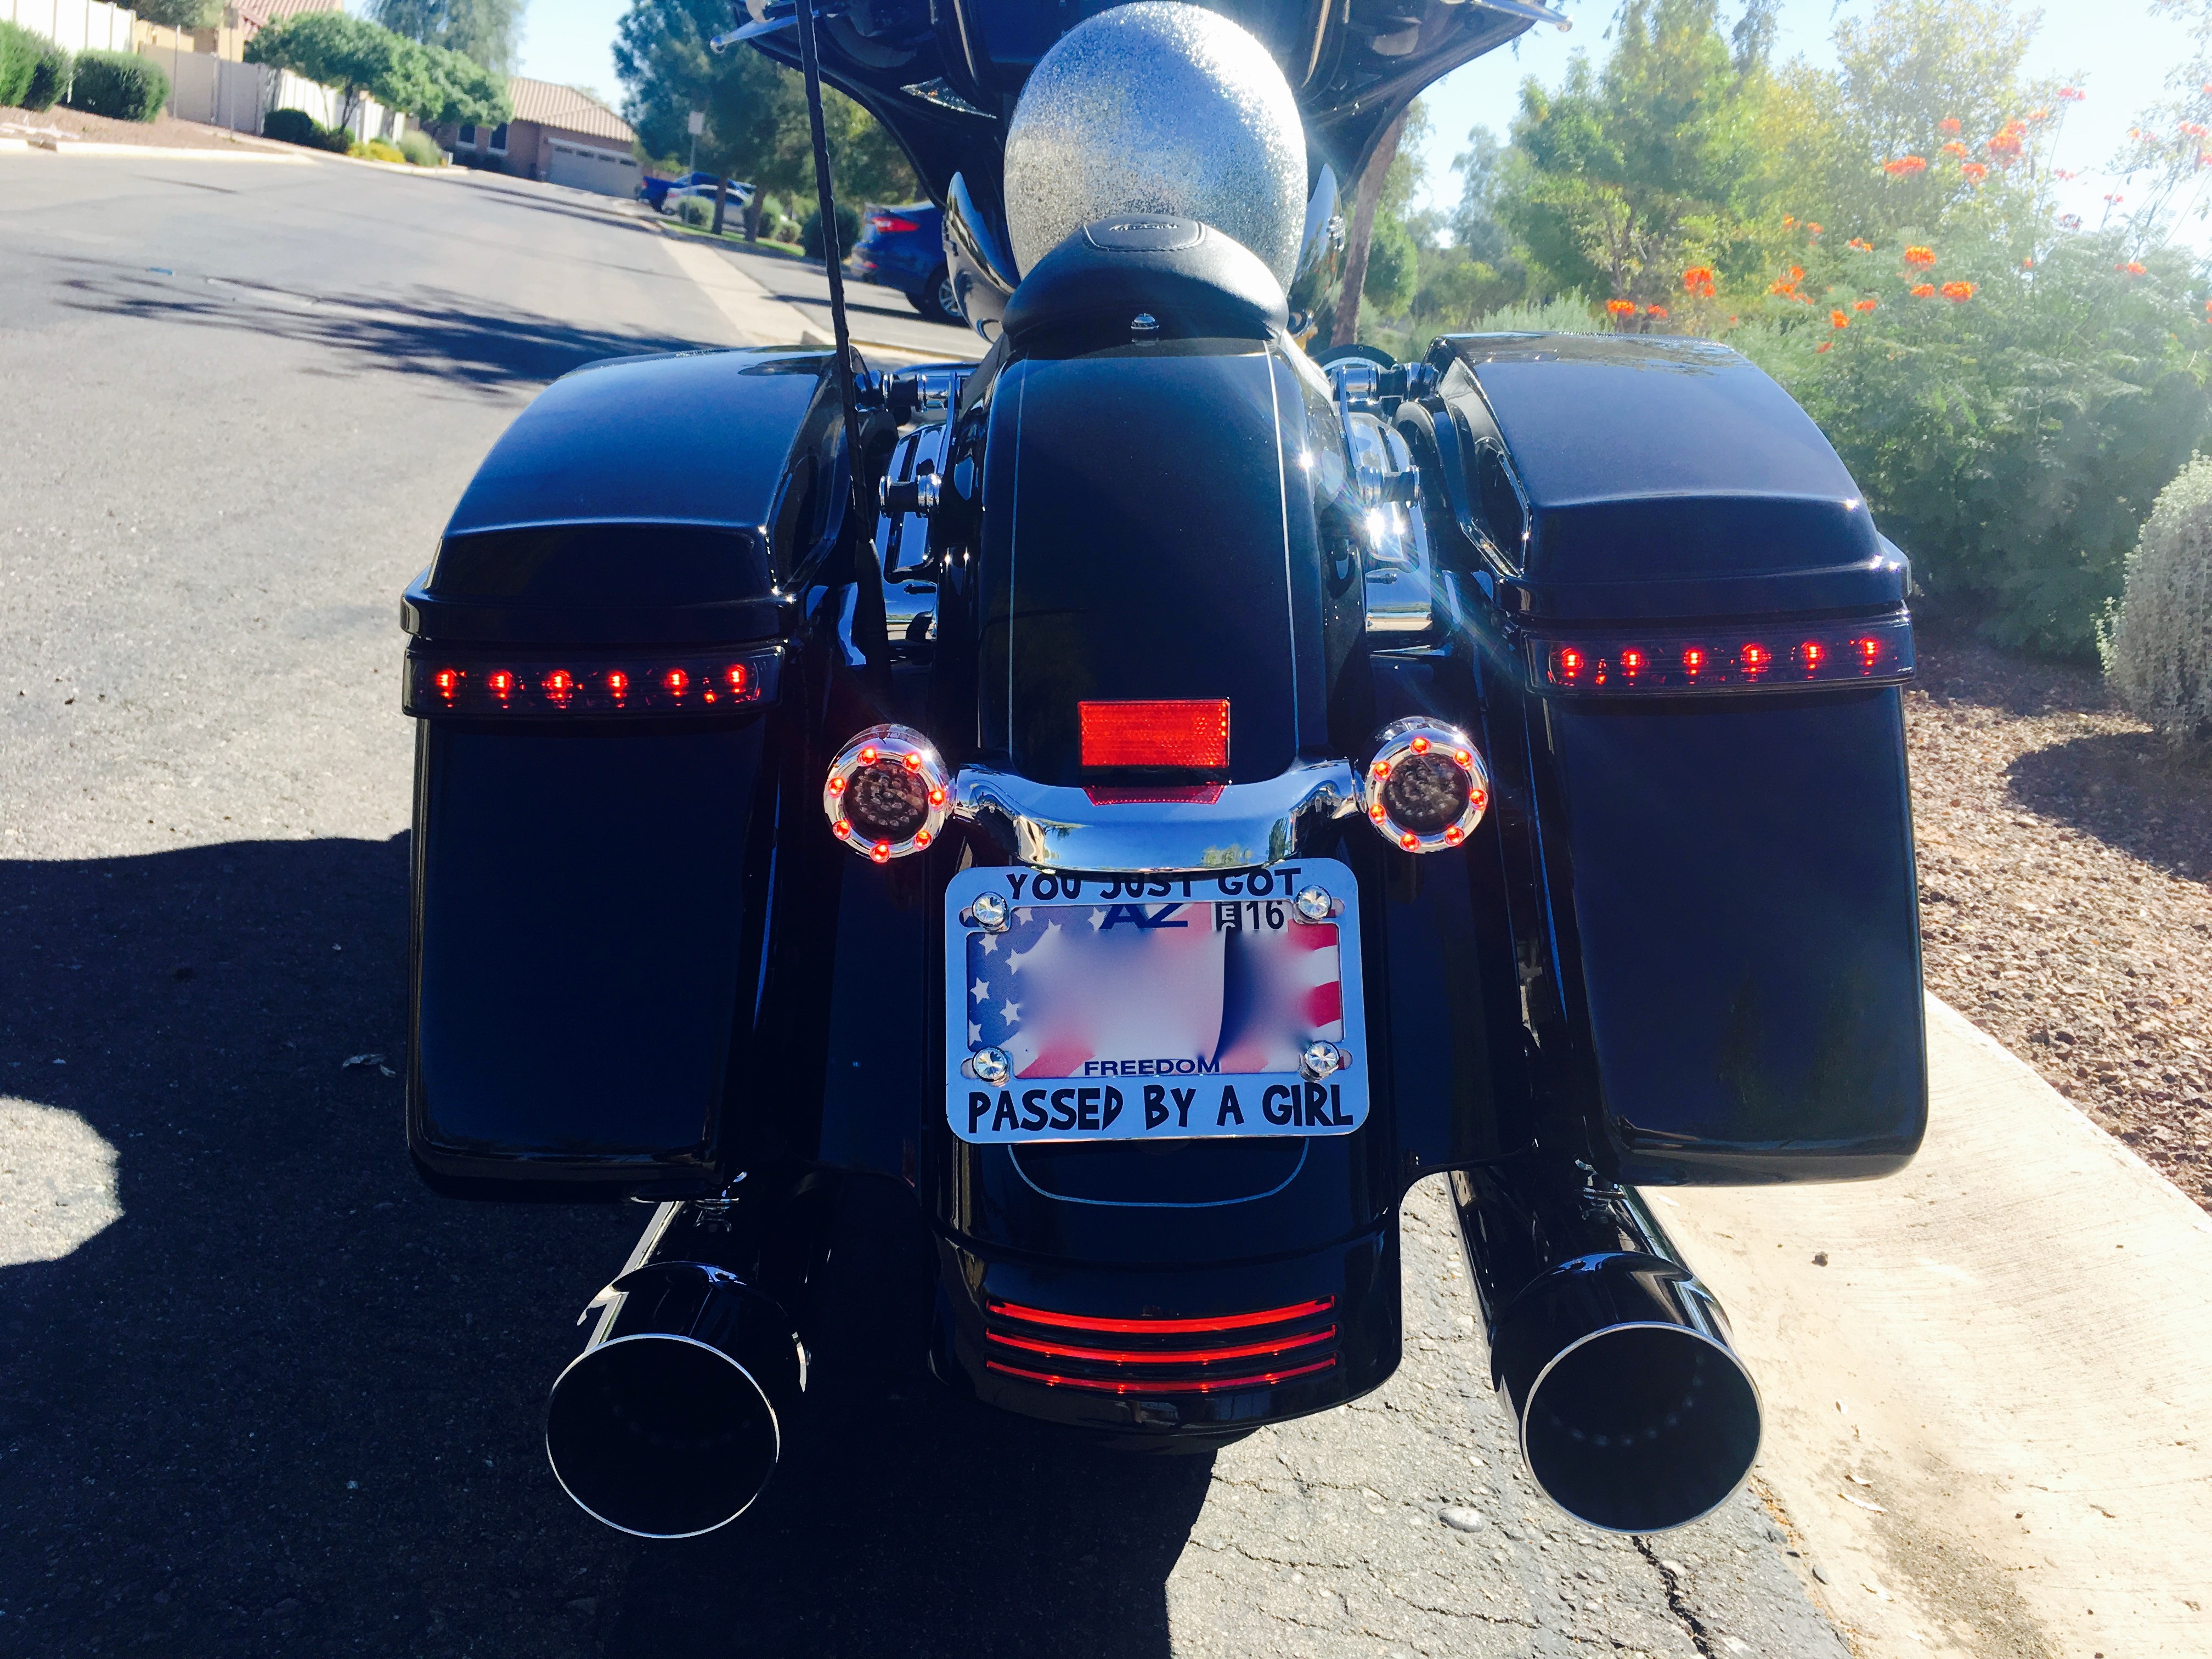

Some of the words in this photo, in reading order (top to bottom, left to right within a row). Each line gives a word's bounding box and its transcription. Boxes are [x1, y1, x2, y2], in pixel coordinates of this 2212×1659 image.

[1006, 873, 1081, 900] YOU
[1099, 872, 1191, 899] JUST
[1218, 868, 1301, 896] GOT
[1099, 903, 1188, 929] AZ
[1246, 901, 1284, 929] 16
[1084, 1059, 1220, 1076] FREEDOM
[968, 1085, 1123, 1133] PASSED
[1143, 1084, 1197, 1130] BY
[1216, 1085, 1244, 1126] A
[1262, 1082, 1353, 1127] GIRL
